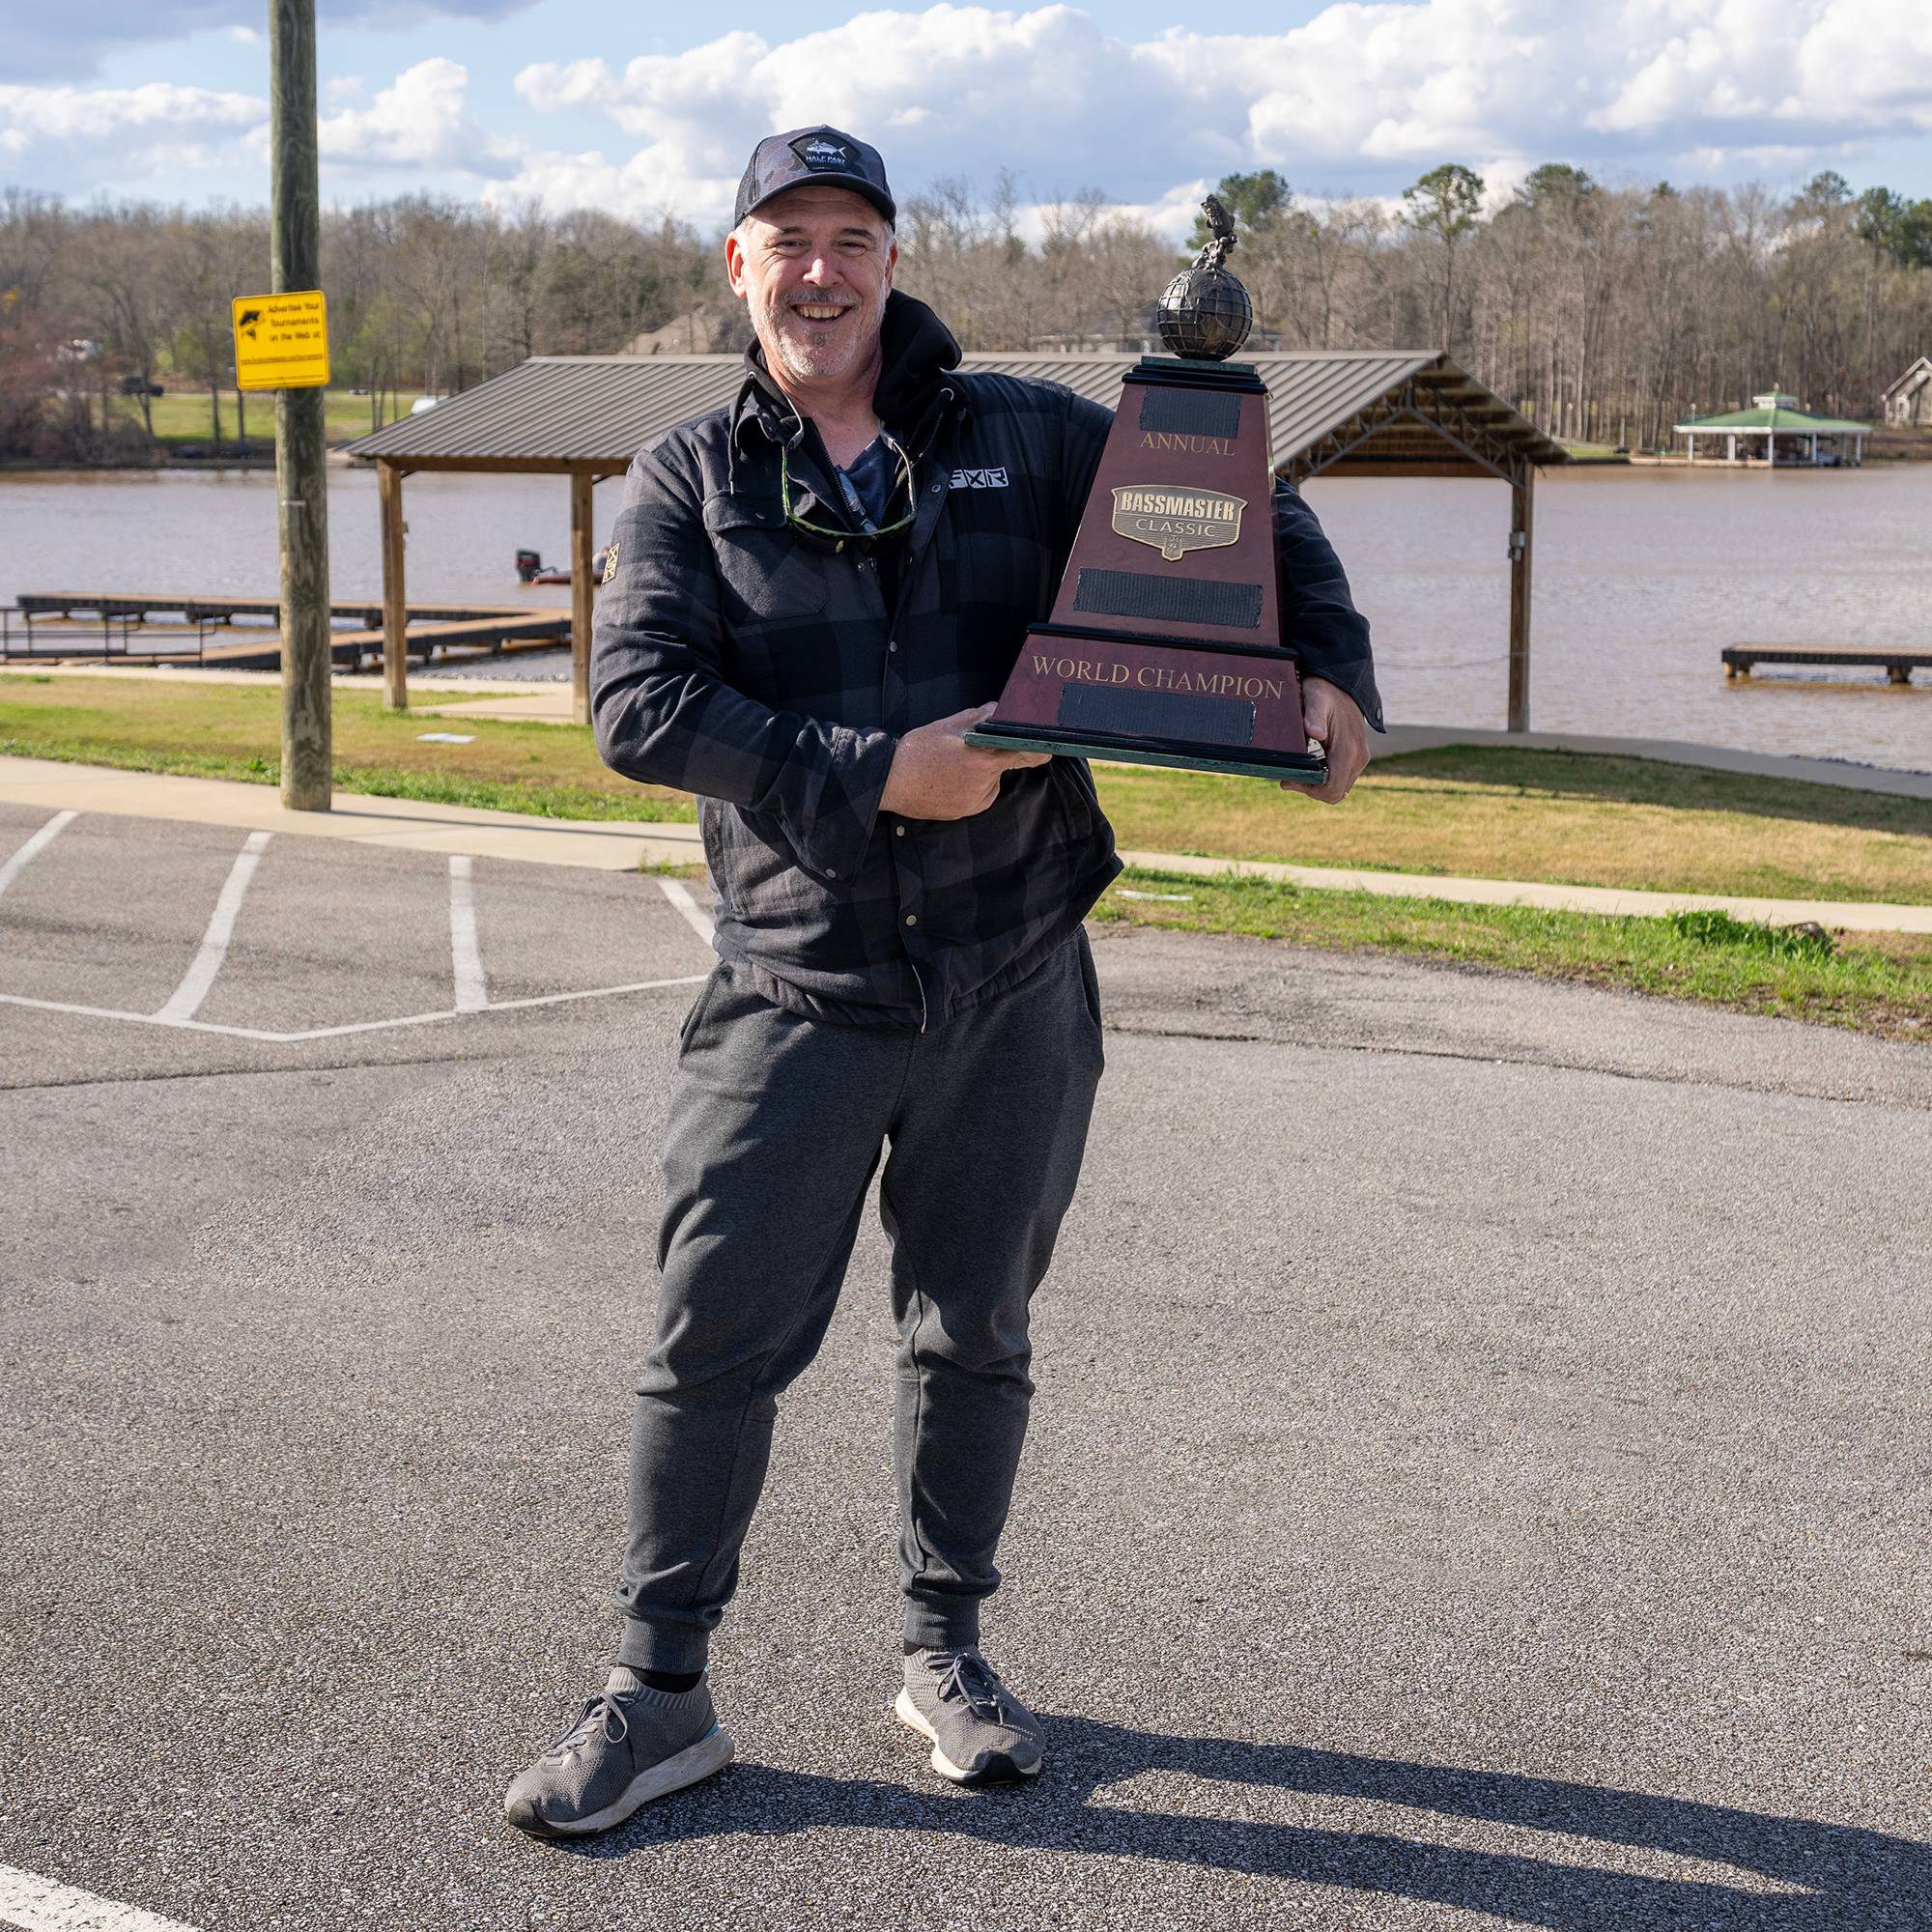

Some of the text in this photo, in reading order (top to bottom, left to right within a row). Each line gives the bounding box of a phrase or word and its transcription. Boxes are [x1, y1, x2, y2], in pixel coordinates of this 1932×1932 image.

[827, 156, 846, 164] PAST
[1139, 432, 1236, 457] ANNUAL
[1121, 491, 1236, 522] BASSMASTER
[1135, 518, 1216, 537] CLASSIC
[1032, 655, 1286, 700] WORLD CHAMPION
